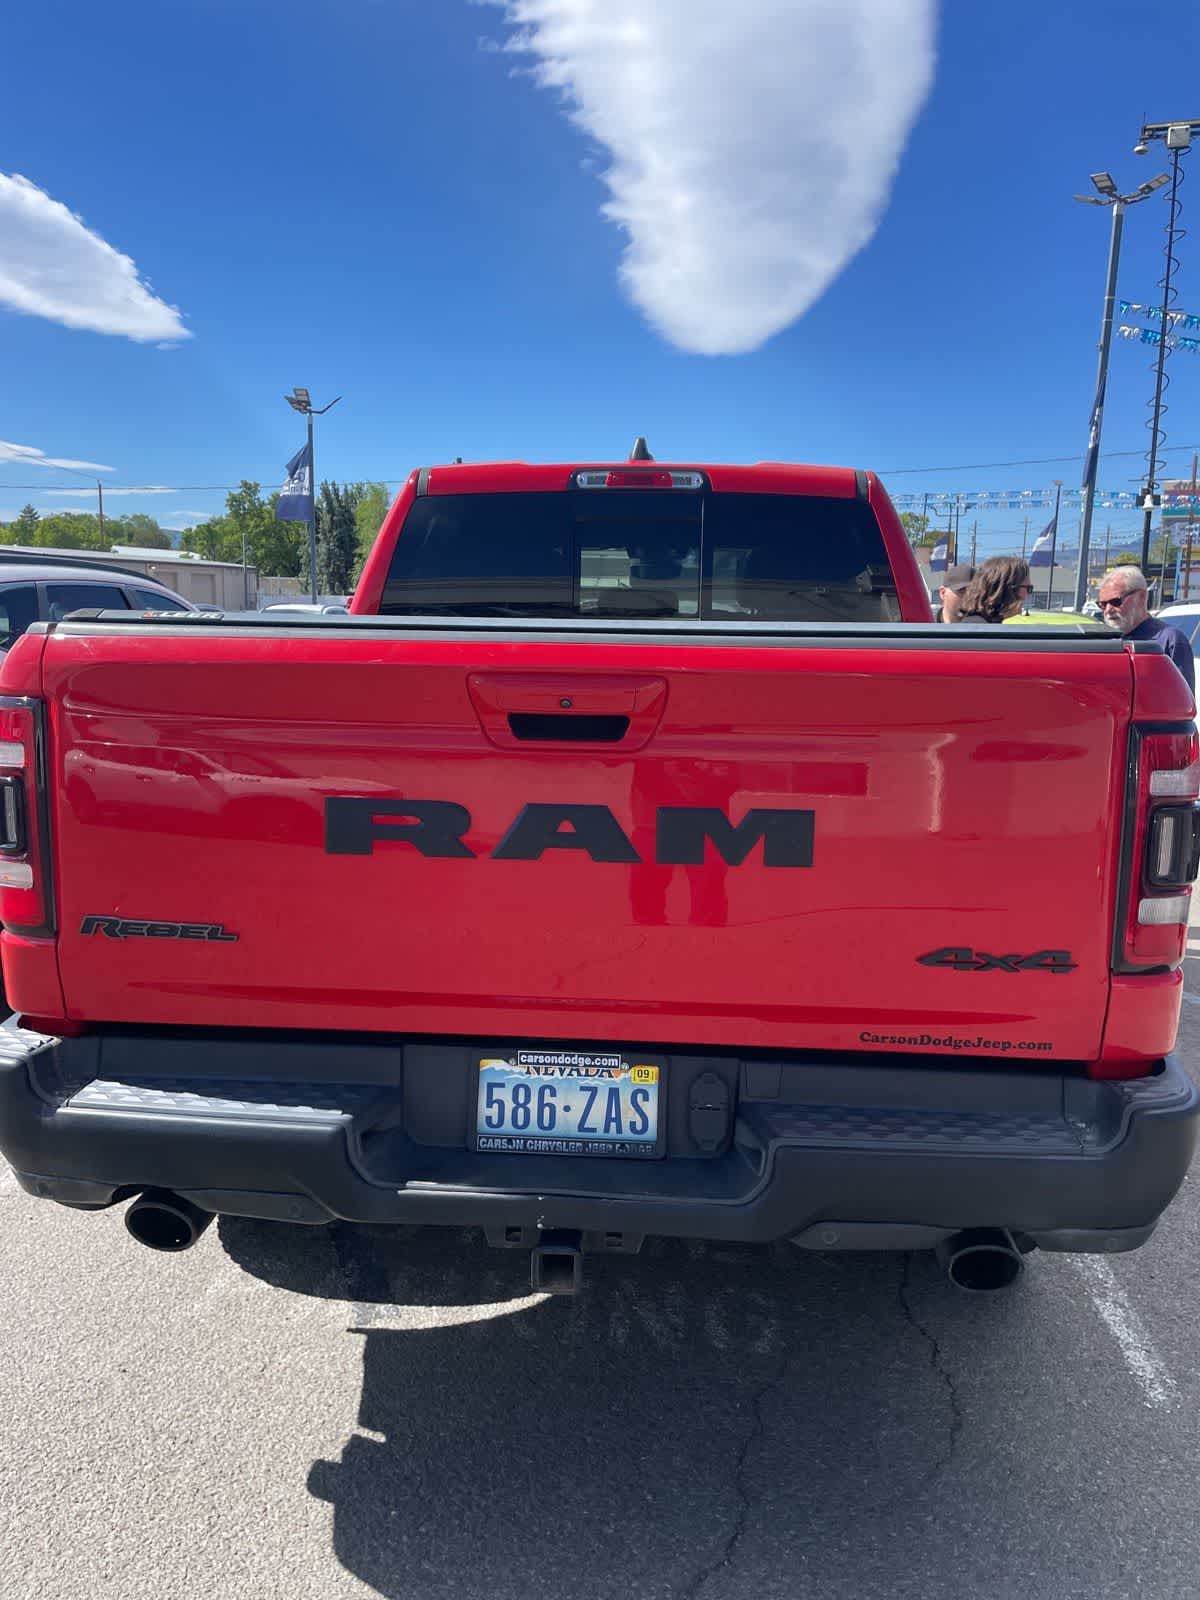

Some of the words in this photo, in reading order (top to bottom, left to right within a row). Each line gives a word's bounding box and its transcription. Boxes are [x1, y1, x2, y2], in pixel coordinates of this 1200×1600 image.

[325, 797, 816, 868] RAM
[80, 914, 239, 942] REBEL
[915, 947, 1079, 974] 4x4
[859, 1031, 1053, 1051] CarsonDodgeJeep.com
[520, 1053, 619, 1067] carsondodge.com
[637, 1069, 650, 1079] 09
